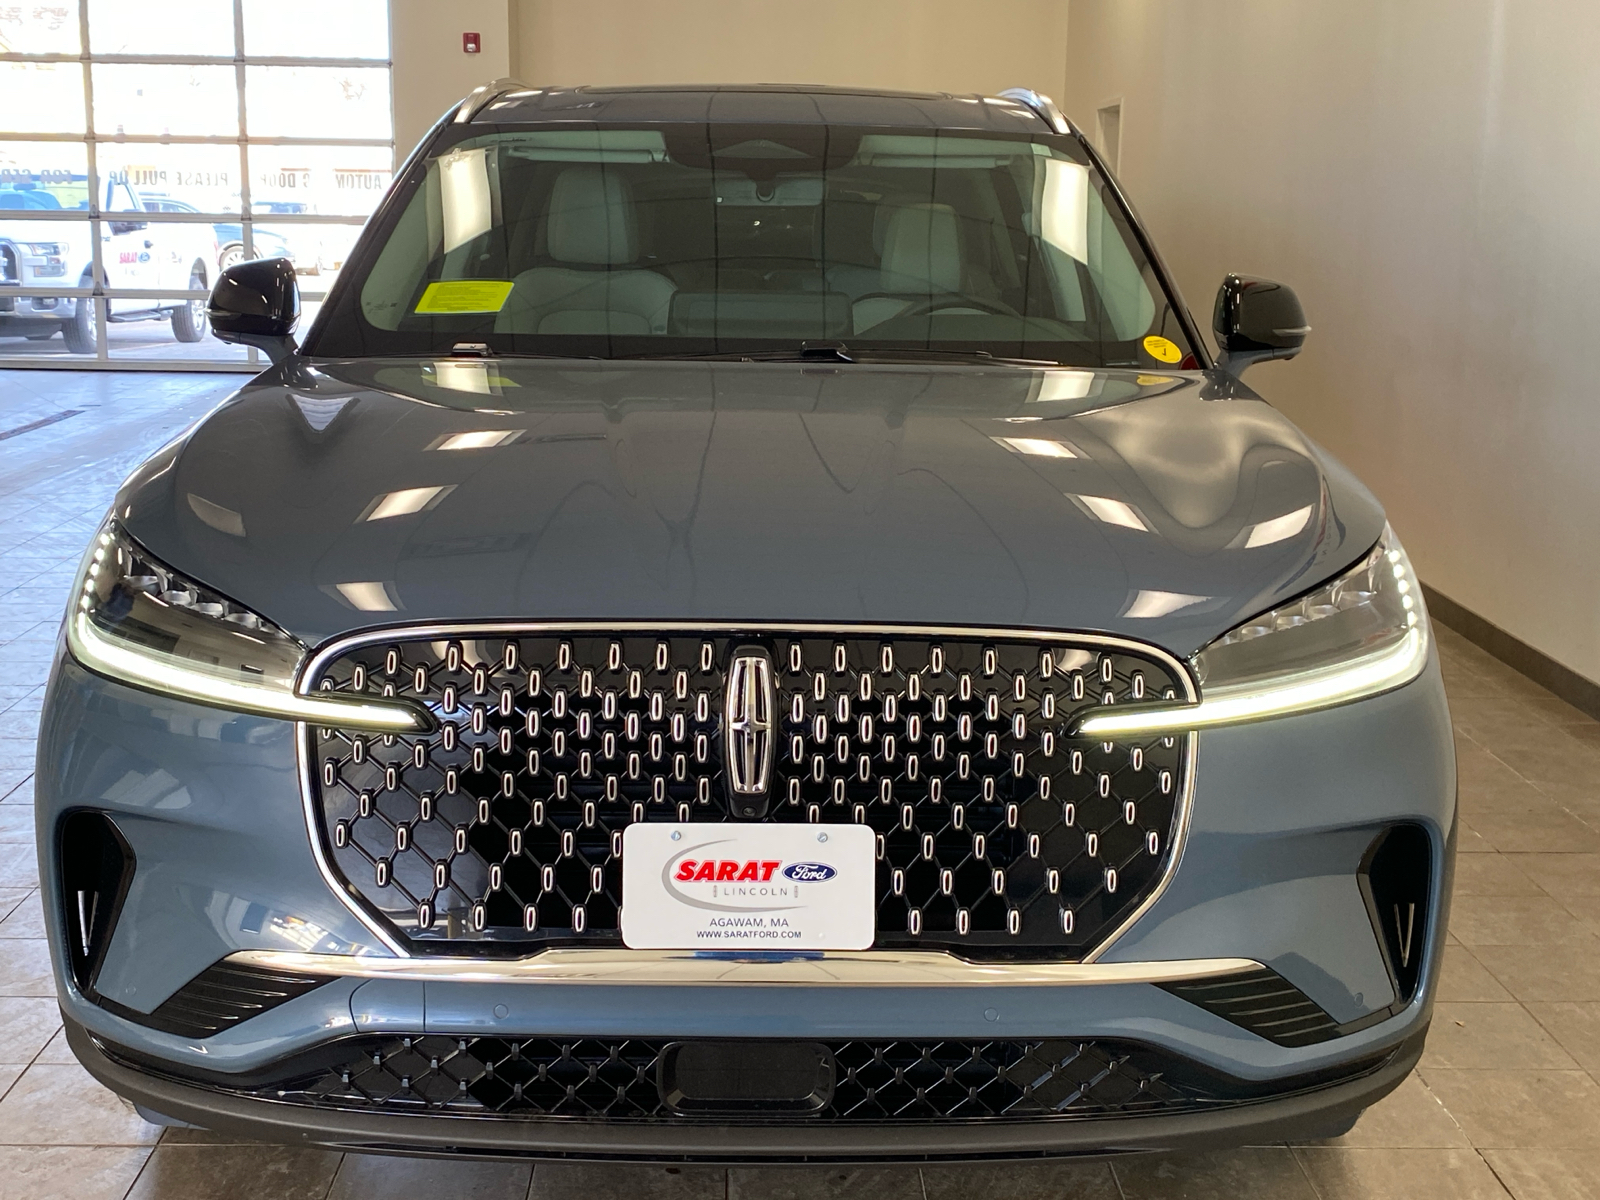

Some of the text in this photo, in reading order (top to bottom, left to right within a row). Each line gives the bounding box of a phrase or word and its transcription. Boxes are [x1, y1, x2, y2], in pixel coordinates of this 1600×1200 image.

[674, 858, 829, 883] SARAT Ford
[723, 887, 788, 896] LINCOLN
[709, 917, 789, 928] AGAWAM, MA
[696, 930, 802, 939] WWW.SARATFORD.COM
